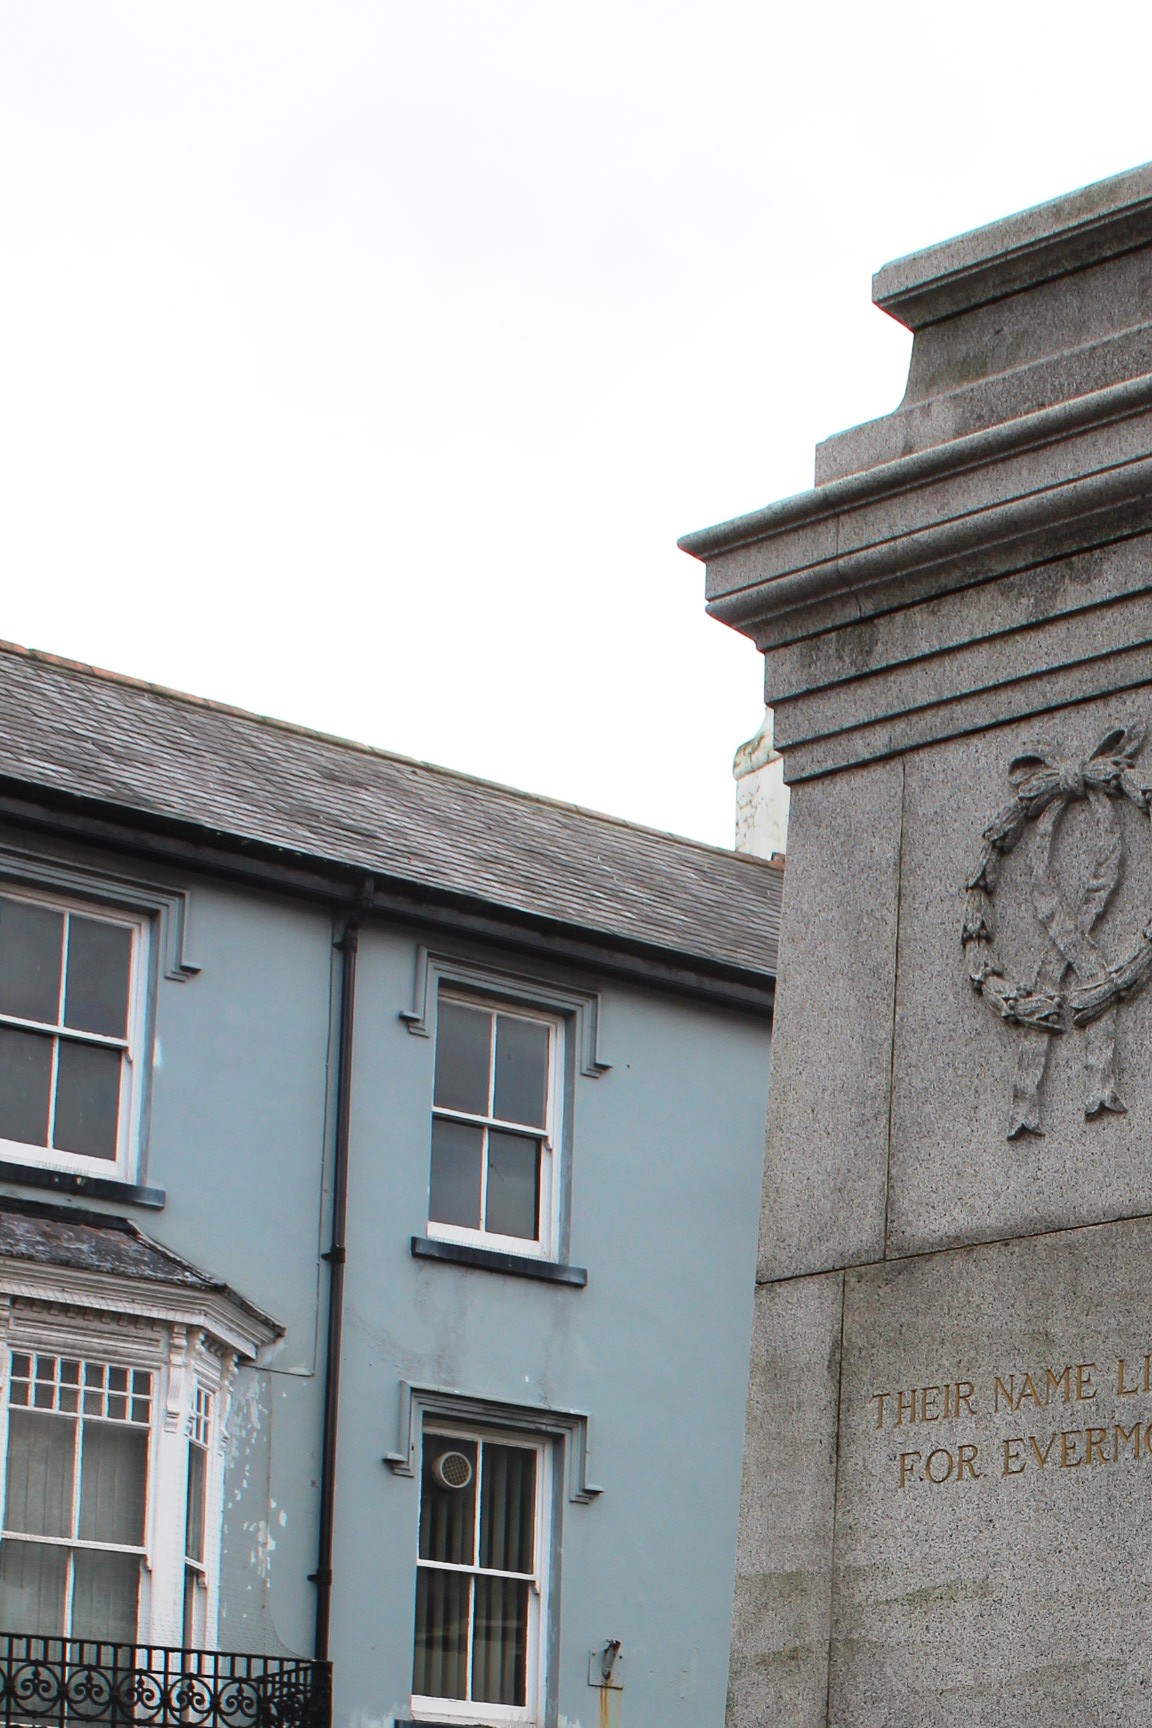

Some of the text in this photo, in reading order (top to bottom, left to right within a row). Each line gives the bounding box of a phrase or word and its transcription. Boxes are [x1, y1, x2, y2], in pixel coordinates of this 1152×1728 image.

[871, 1381, 977, 1430] THEIR
[994, 1363, 1098, 1413] NAME
[899, 1444, 981, 1489] FOR
